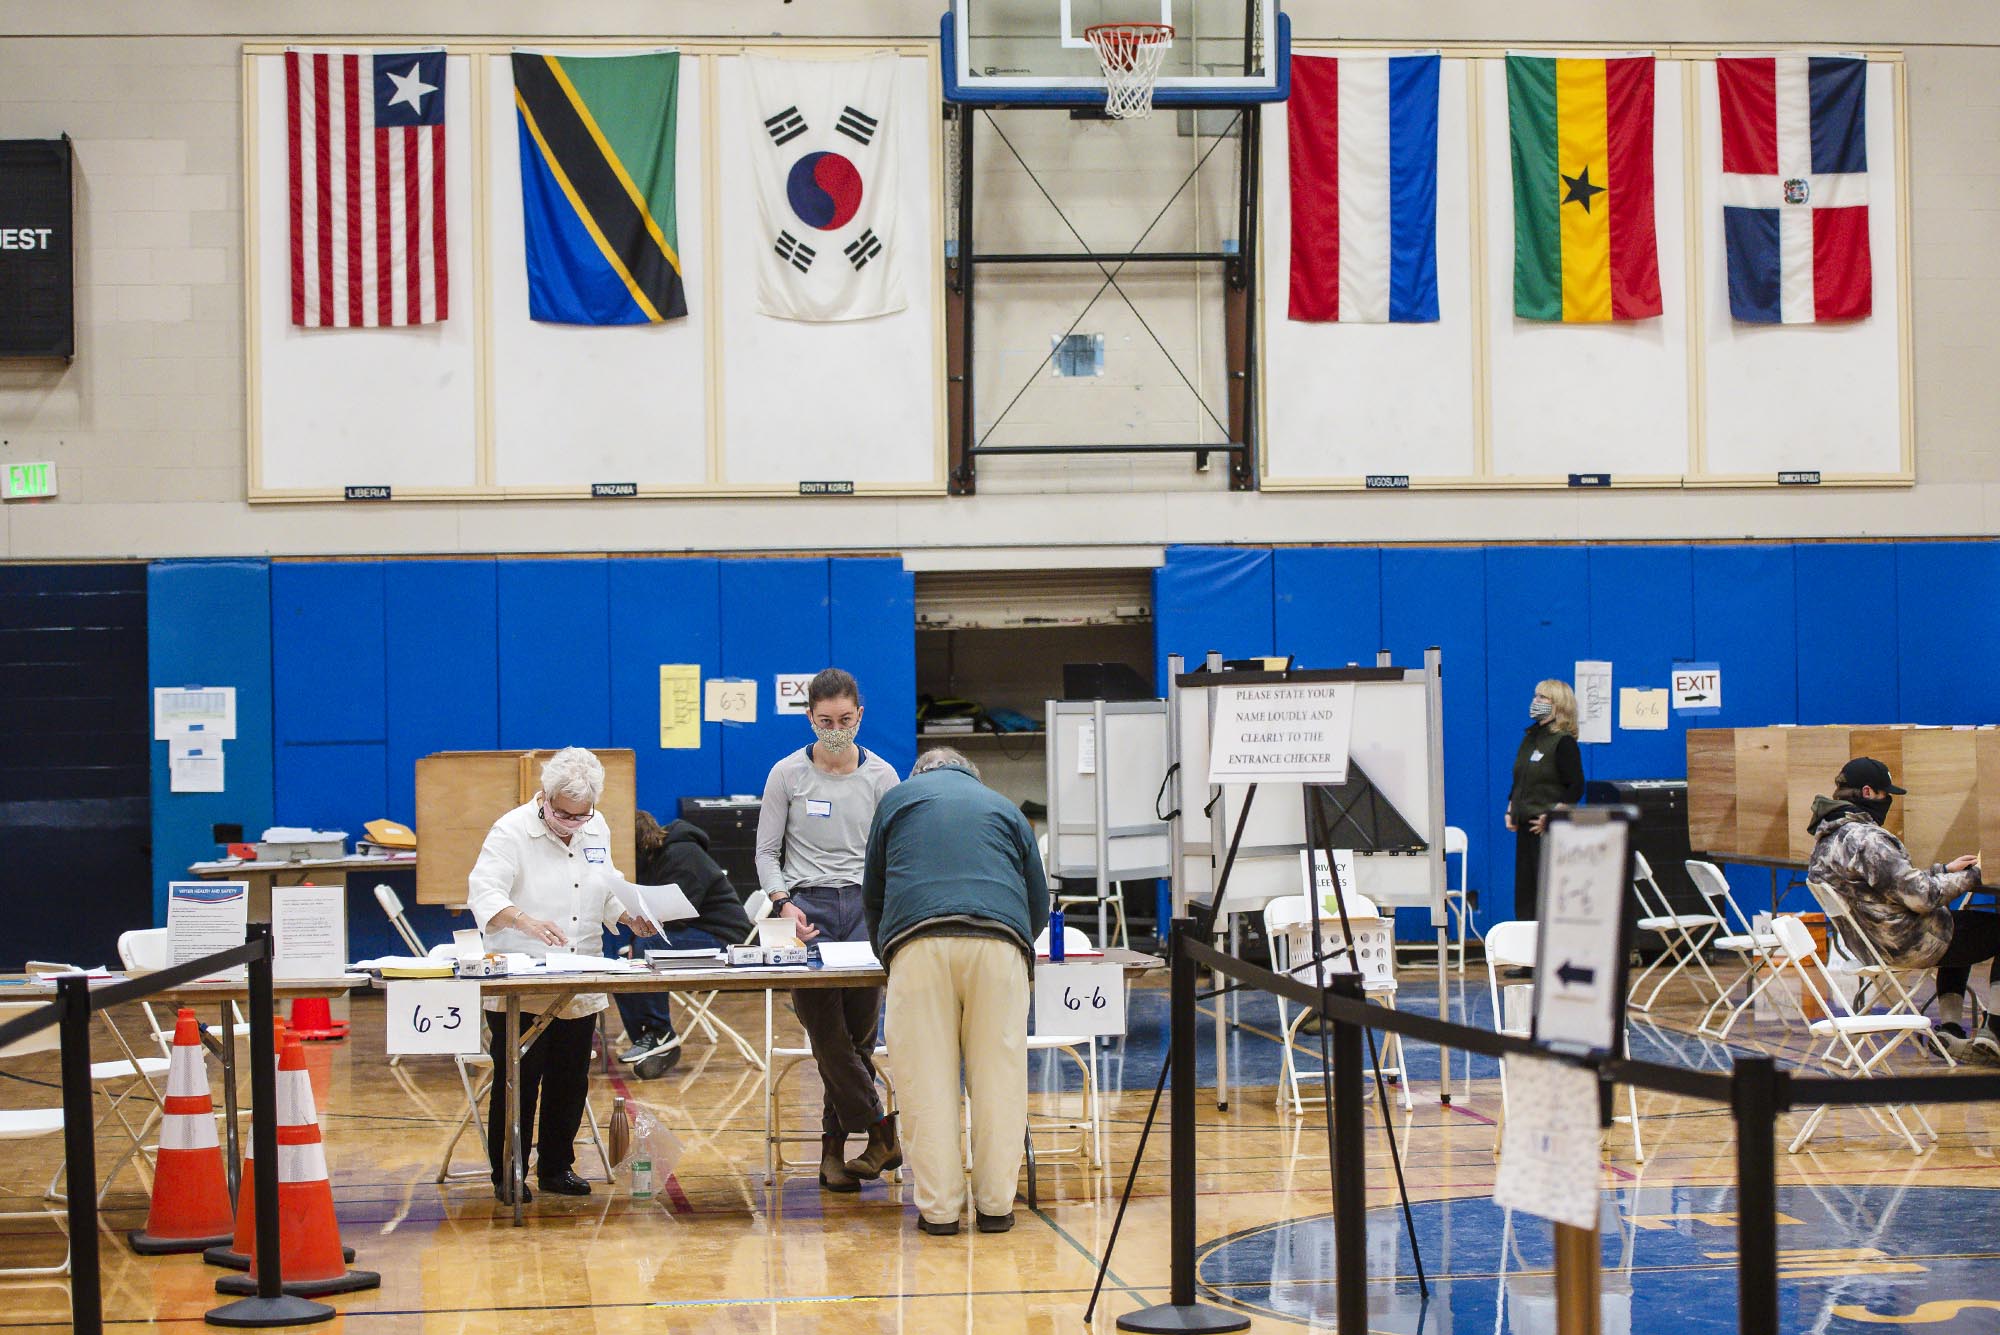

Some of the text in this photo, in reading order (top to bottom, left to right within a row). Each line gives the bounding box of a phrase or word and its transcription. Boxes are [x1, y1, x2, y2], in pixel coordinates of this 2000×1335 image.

[0, 228, 52, 250] EST
[9, 464, 49, 496] EXIT
[1366, 477, 1408, 487] YUGOSLAVIA
[348, 487, 387, 497] LIBERIA
[595, 485, 634, 495] TANZANIA
[801, 483, 852, 492] SOUTH KOREA
[780, 681, 809, 697] EX
[1676, 675, 1717, 691] EXIT
[1236, 688, 1336, 700] PLEASE STATE YOUR
[719, 692, 747, 711] 6-3
[1235, 710, 1333, 722] NAME LOUDLY AND
[1241, 731, 1325, 743] CLEARLY TO THE
[1228, 752, 1332, 765] ENTRANCE CHECKER
[1314, 863, 1347, 872] RIVCY
[1064, 986, 1106, 1010] 6-6
[413, 1004, 461, 1033] 6-3
